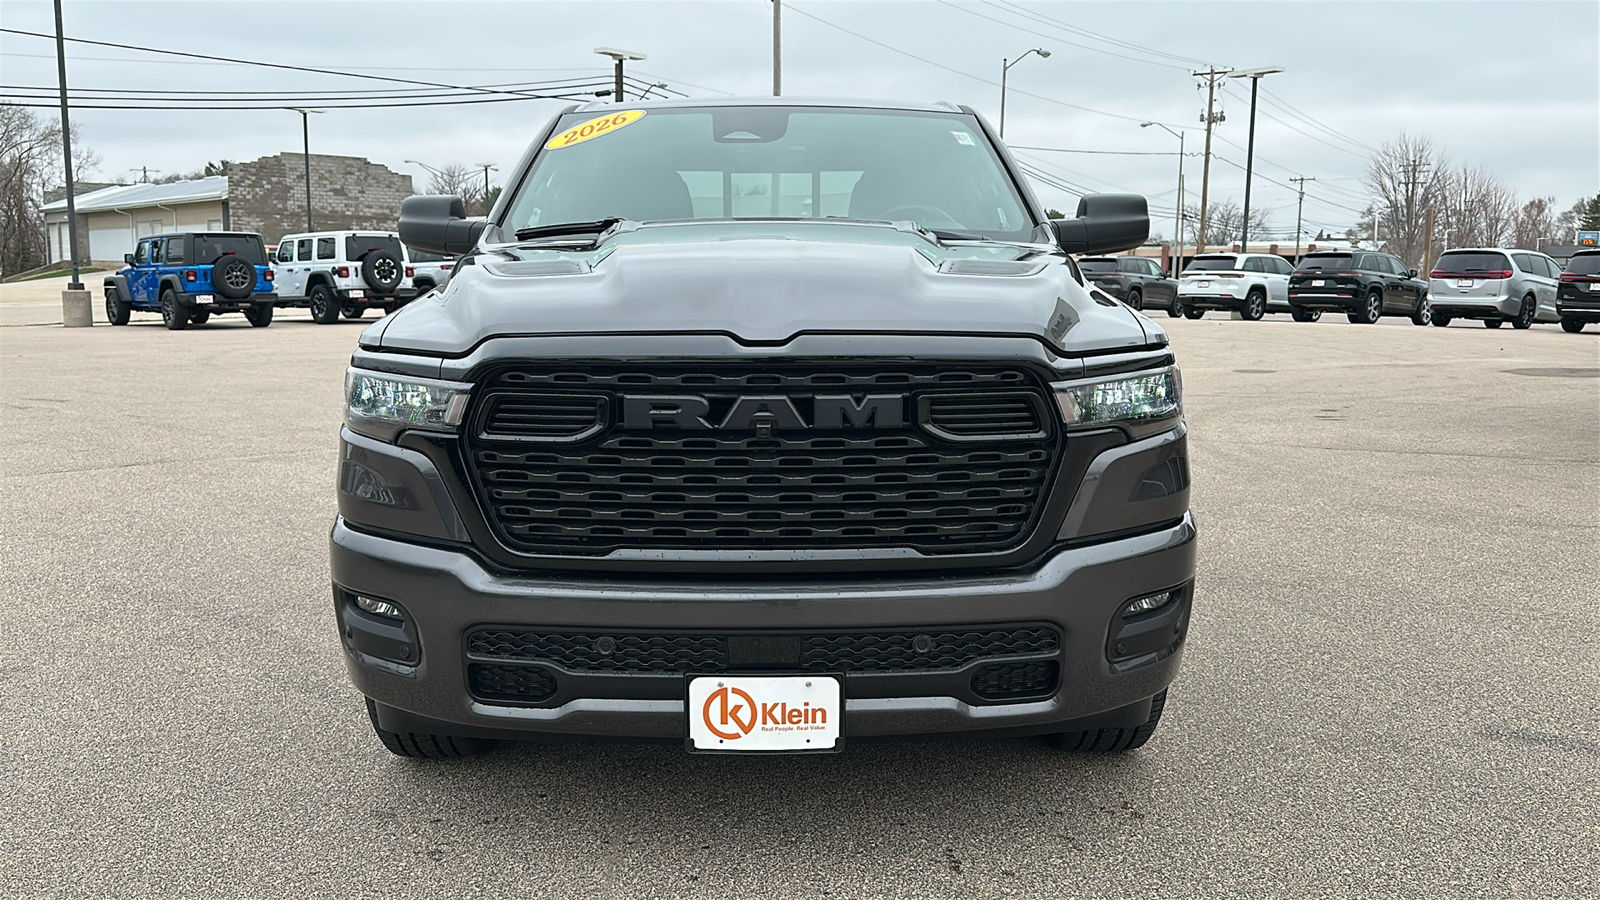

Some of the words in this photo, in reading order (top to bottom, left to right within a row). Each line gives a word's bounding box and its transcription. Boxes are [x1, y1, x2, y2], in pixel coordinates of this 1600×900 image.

[563, 112, 627, 145] 2026
[623, 394, 904, 429] RAM
[761, 702, 827, 725] Klein
